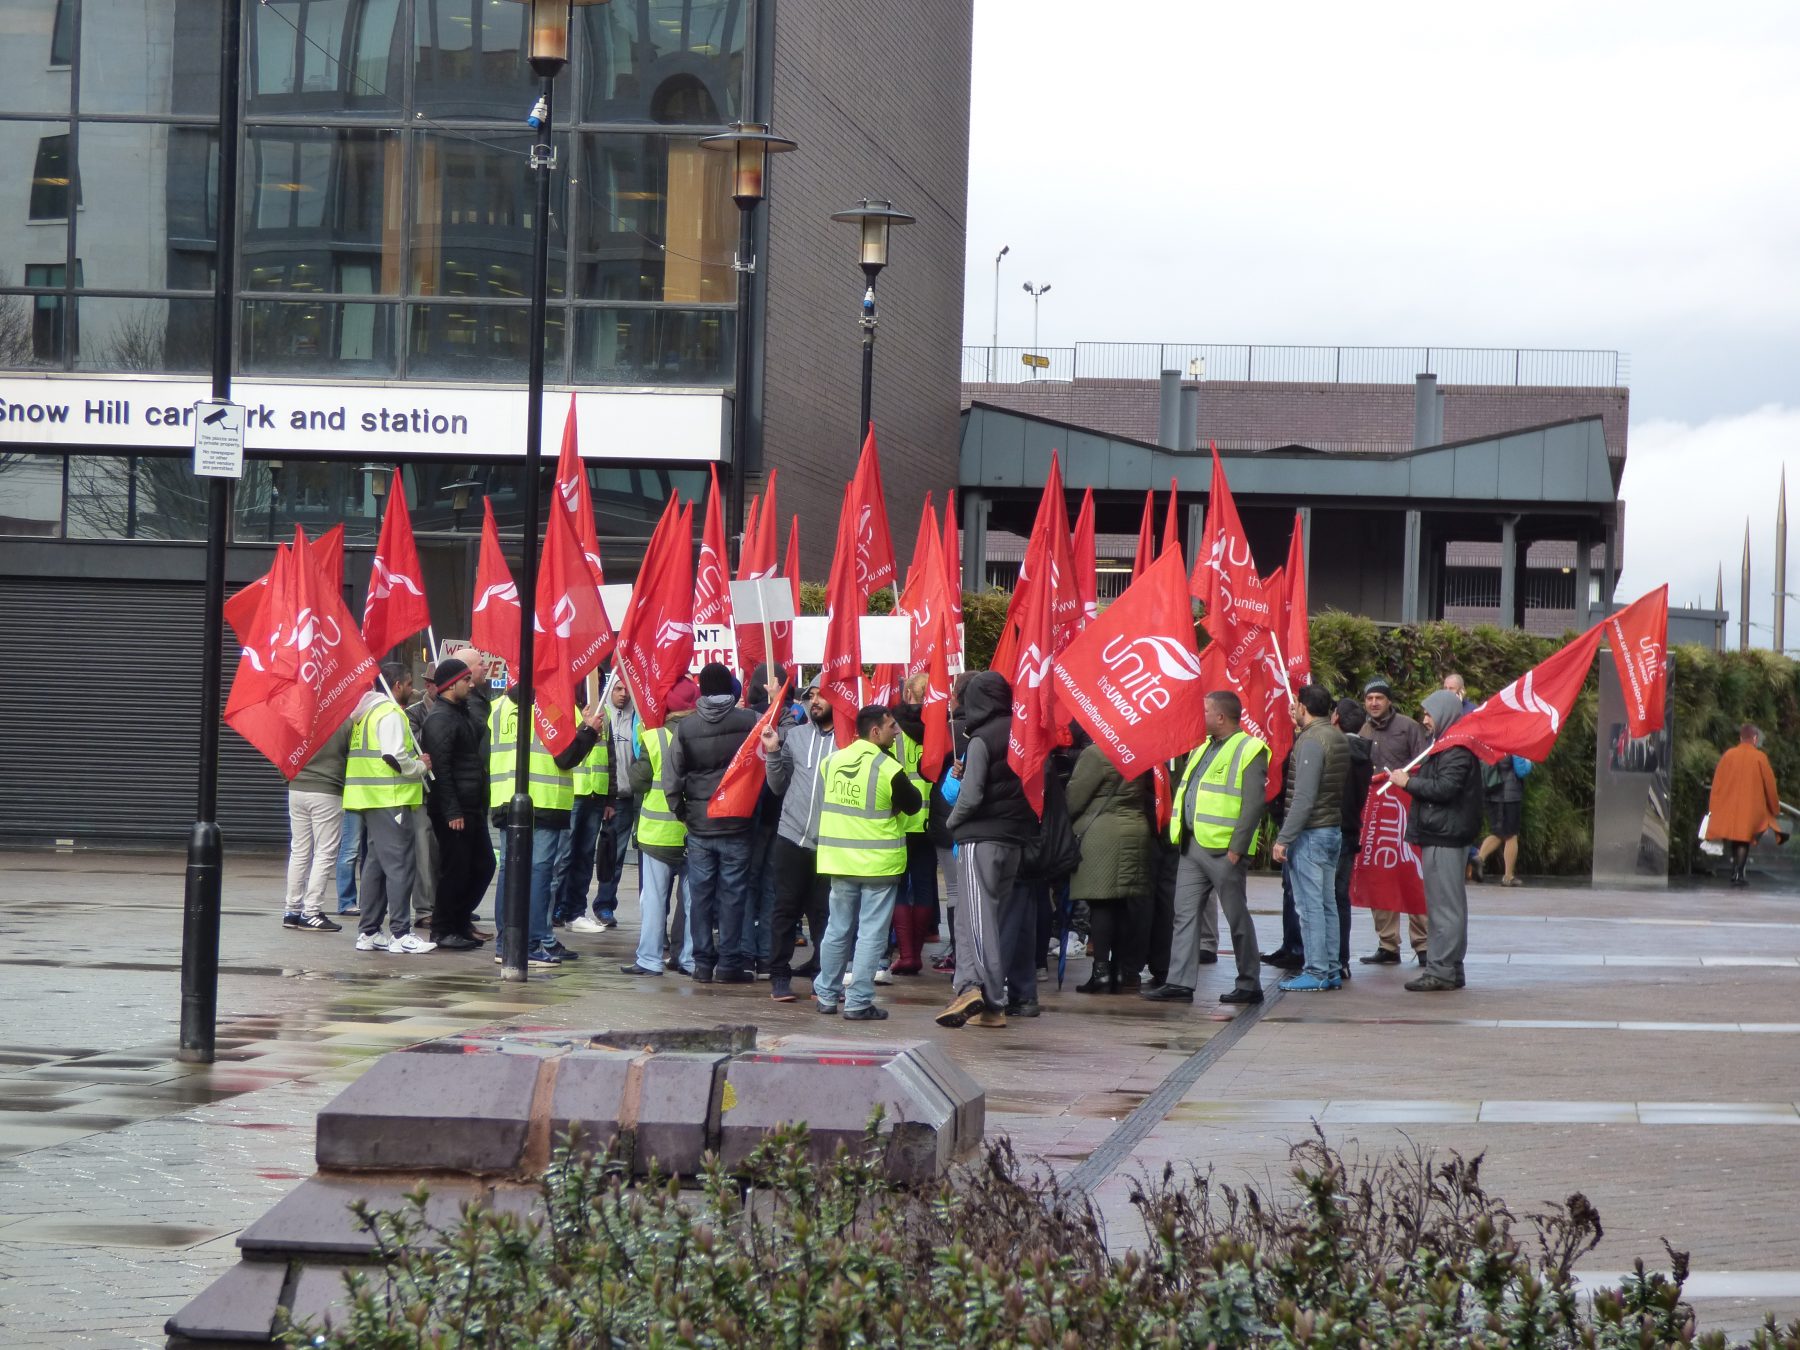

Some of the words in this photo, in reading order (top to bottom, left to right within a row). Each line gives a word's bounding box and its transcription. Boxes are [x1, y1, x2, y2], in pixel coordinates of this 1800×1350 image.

[84, 399, 130, 424] Hill
[145, 406, 194, 427] car
[246, 404, 276, 429] rk
[290, 406, 345, 431] and
[360, 407, 468, 434] station
[1097, 675, 1142, 727] theUNION
[1101, 633, 1172, 714] unite
[1054, 662, 1136, 765] www.unitetheunion.org
